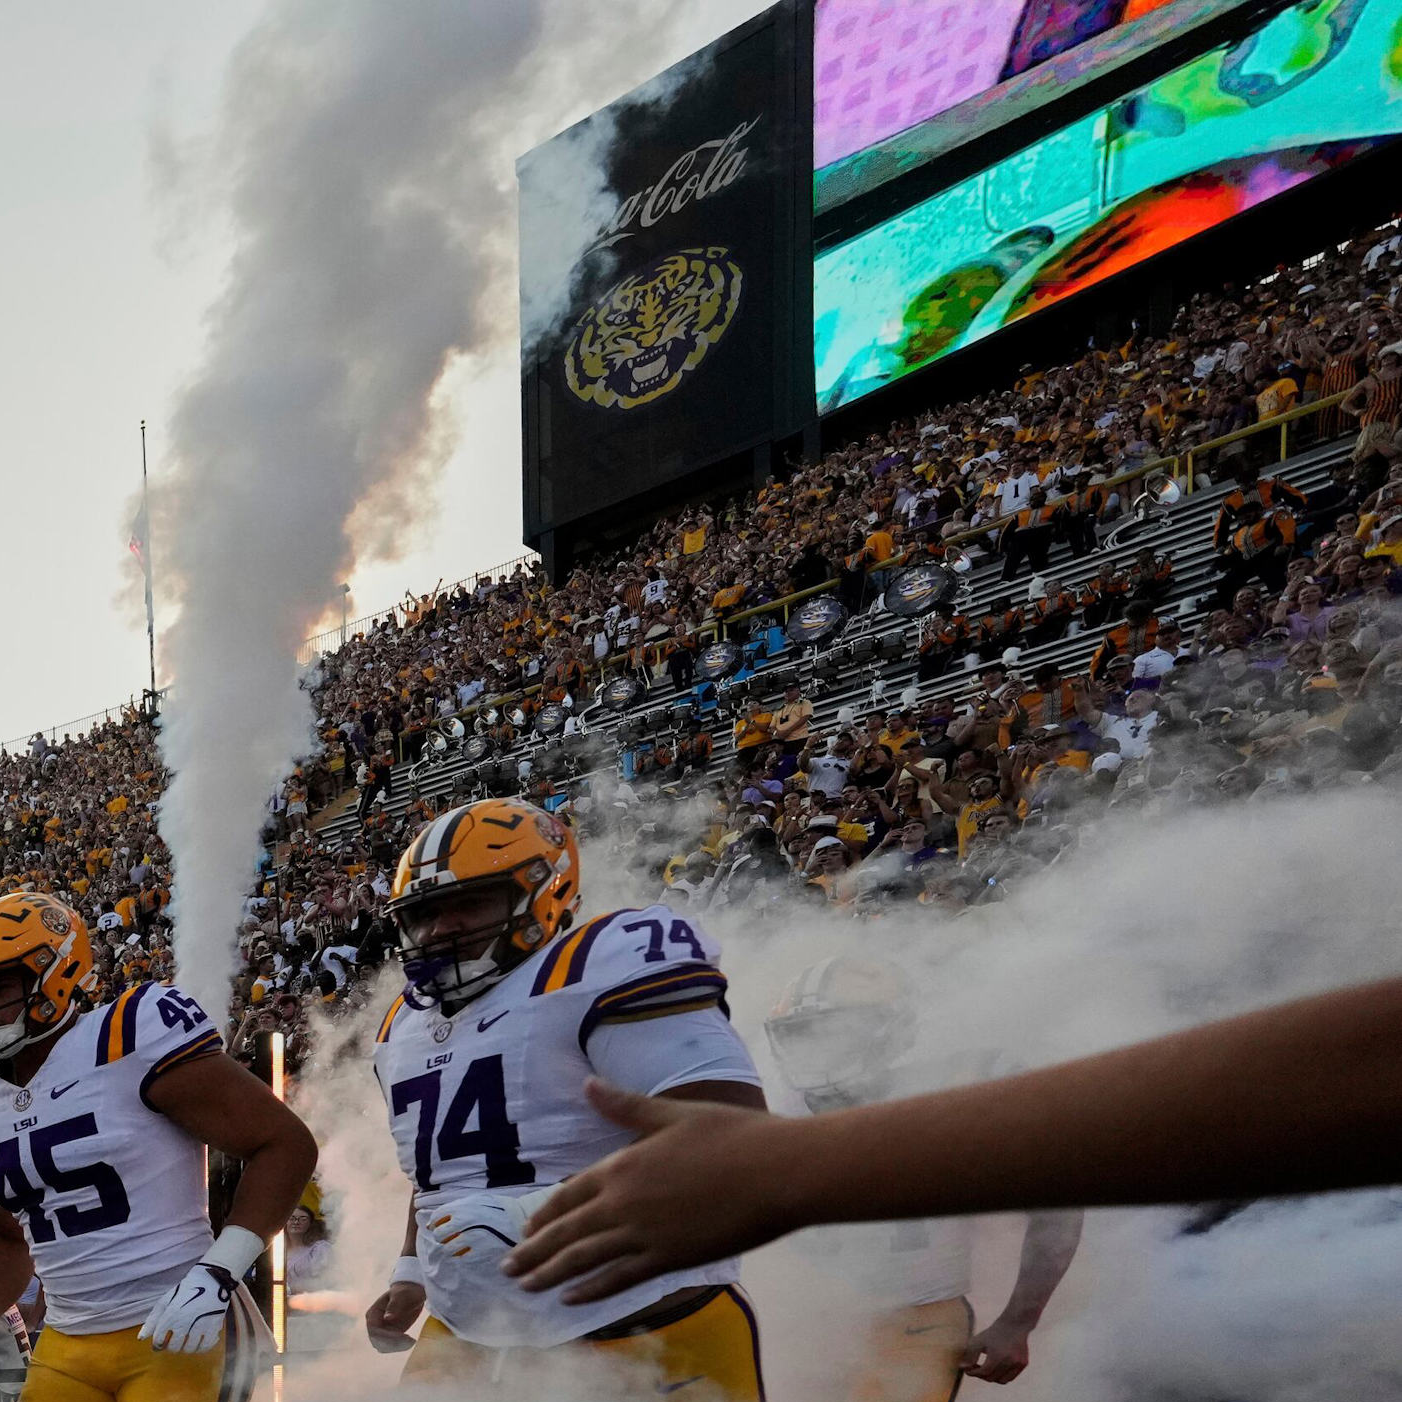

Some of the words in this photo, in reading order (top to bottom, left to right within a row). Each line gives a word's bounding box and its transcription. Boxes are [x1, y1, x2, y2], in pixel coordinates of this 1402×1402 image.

[622, 918, 706, 963] 74
[156, 989, 208, 1034] 45
[427, 1052, 453, 1070] LSU
[13, 1115, 38, 1132] LSU
[390, 1053, 536, 1193] 74
